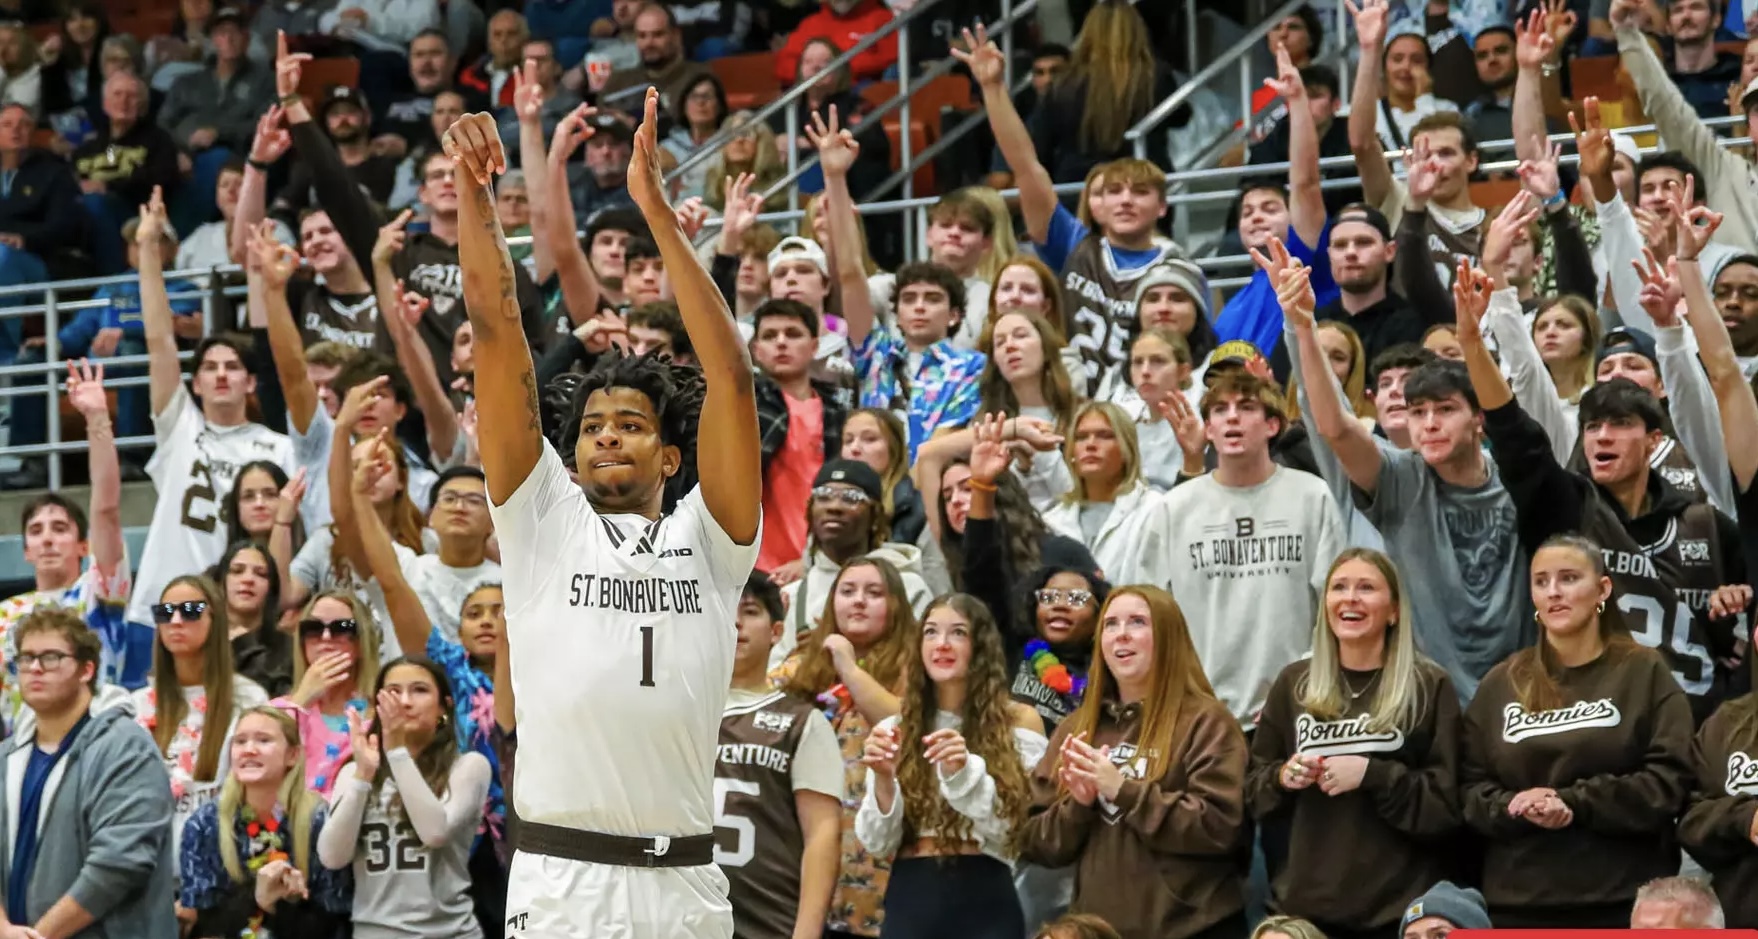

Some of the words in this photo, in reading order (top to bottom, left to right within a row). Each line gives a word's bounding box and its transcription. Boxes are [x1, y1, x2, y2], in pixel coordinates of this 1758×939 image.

[1235, 517, 1255, 538] B
[1212, 534, 1303, 566] BONAVENTURE
[569, 573, 596, 607] ST.
[639, 626, 656, 687] 1
[1297, 715, 1402, 753] Bonni
[1504, 700, 1618, 740] Bonnies
[1727, 754, 1758, 791] Bo
[359, 822, 426, 874] 32
